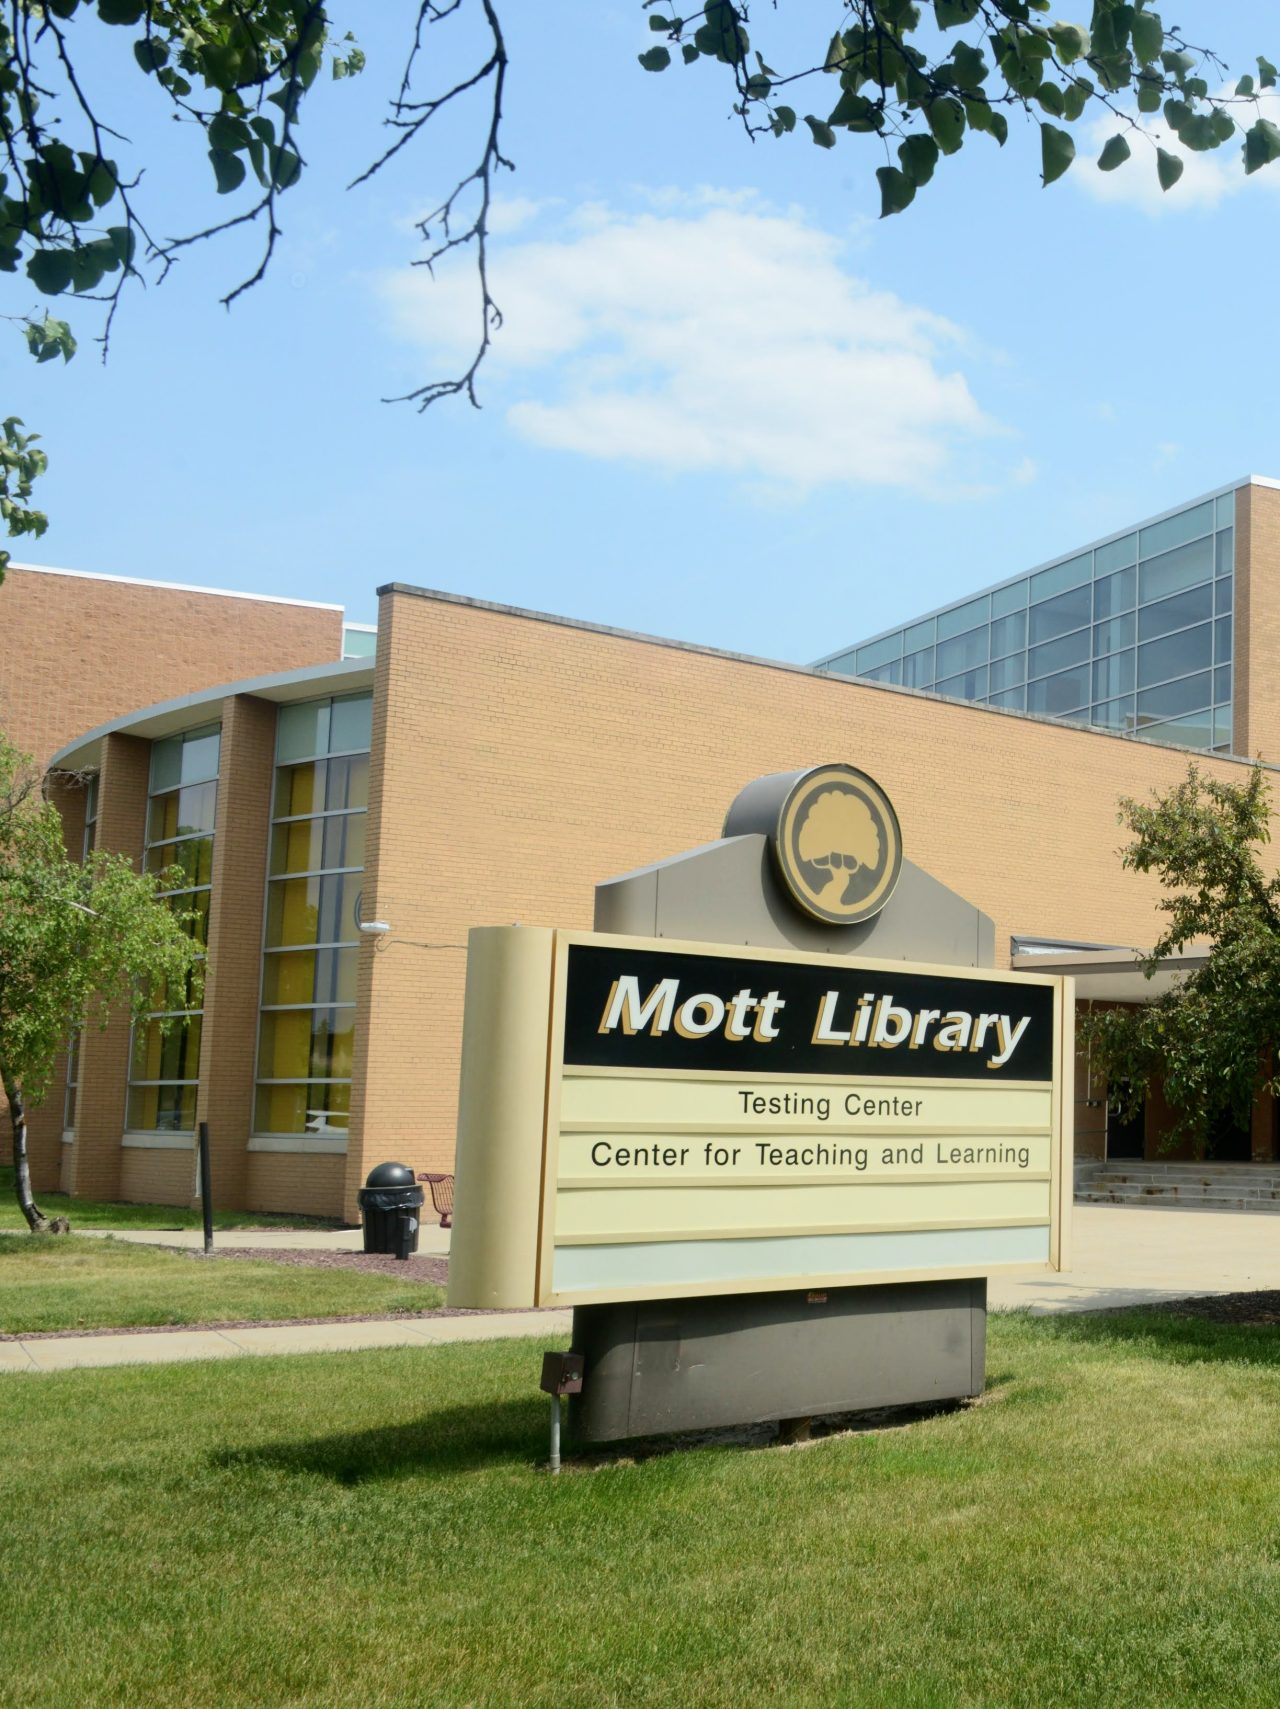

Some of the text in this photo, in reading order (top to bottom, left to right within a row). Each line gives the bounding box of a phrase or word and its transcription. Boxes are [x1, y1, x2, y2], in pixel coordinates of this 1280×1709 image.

[597, 974, 1032, 1069] Mott Library
[738, 1090, 924, 1121] Testing Center
[590, 1141, 1030, 1171] Center for Teaching and Learning
